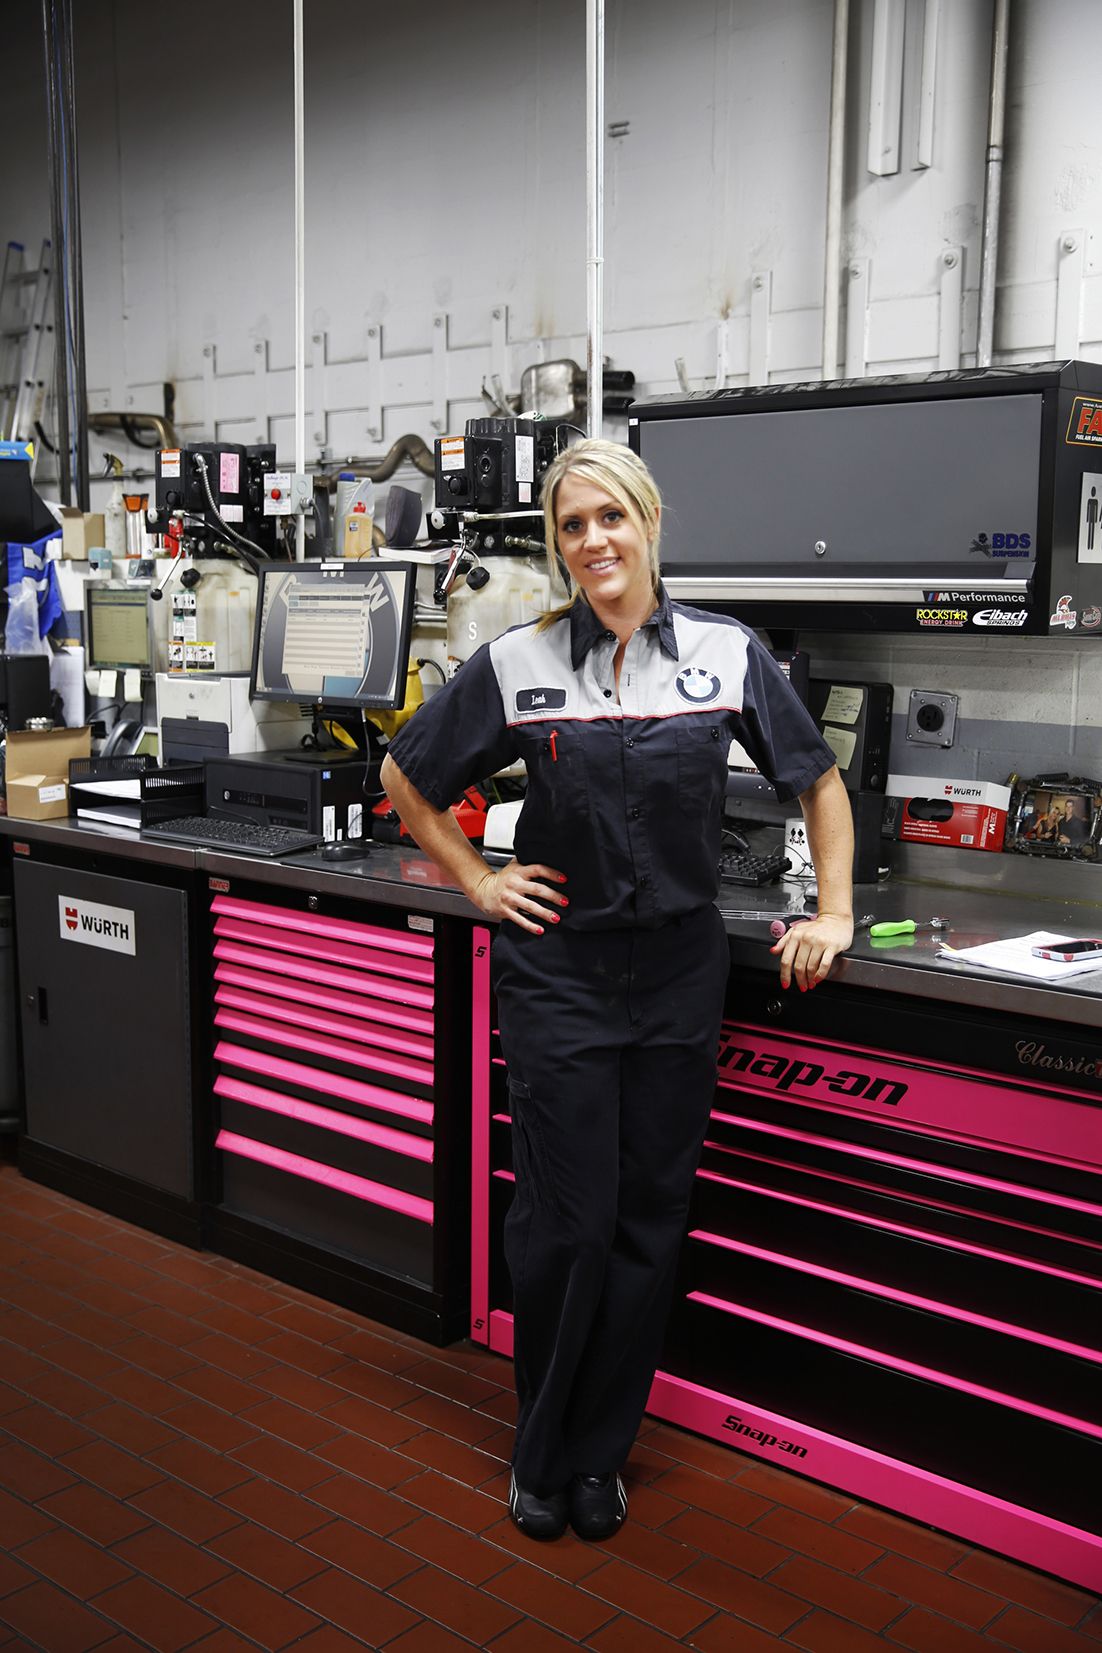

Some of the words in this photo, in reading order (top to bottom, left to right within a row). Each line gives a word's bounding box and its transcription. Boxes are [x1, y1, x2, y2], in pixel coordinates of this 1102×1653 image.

[992, 533, 1031, 549] BDS
[951, 592, 1026, 603] Performance
[468, 621, 478, 641] S
[81, 914, 129, 940] WÜRTH
[718, 1034, 909, 1106] nap-on
[1015, 1040, 1095, 1075] Classic
[721, 1414, 808, 1459] Snap-on
